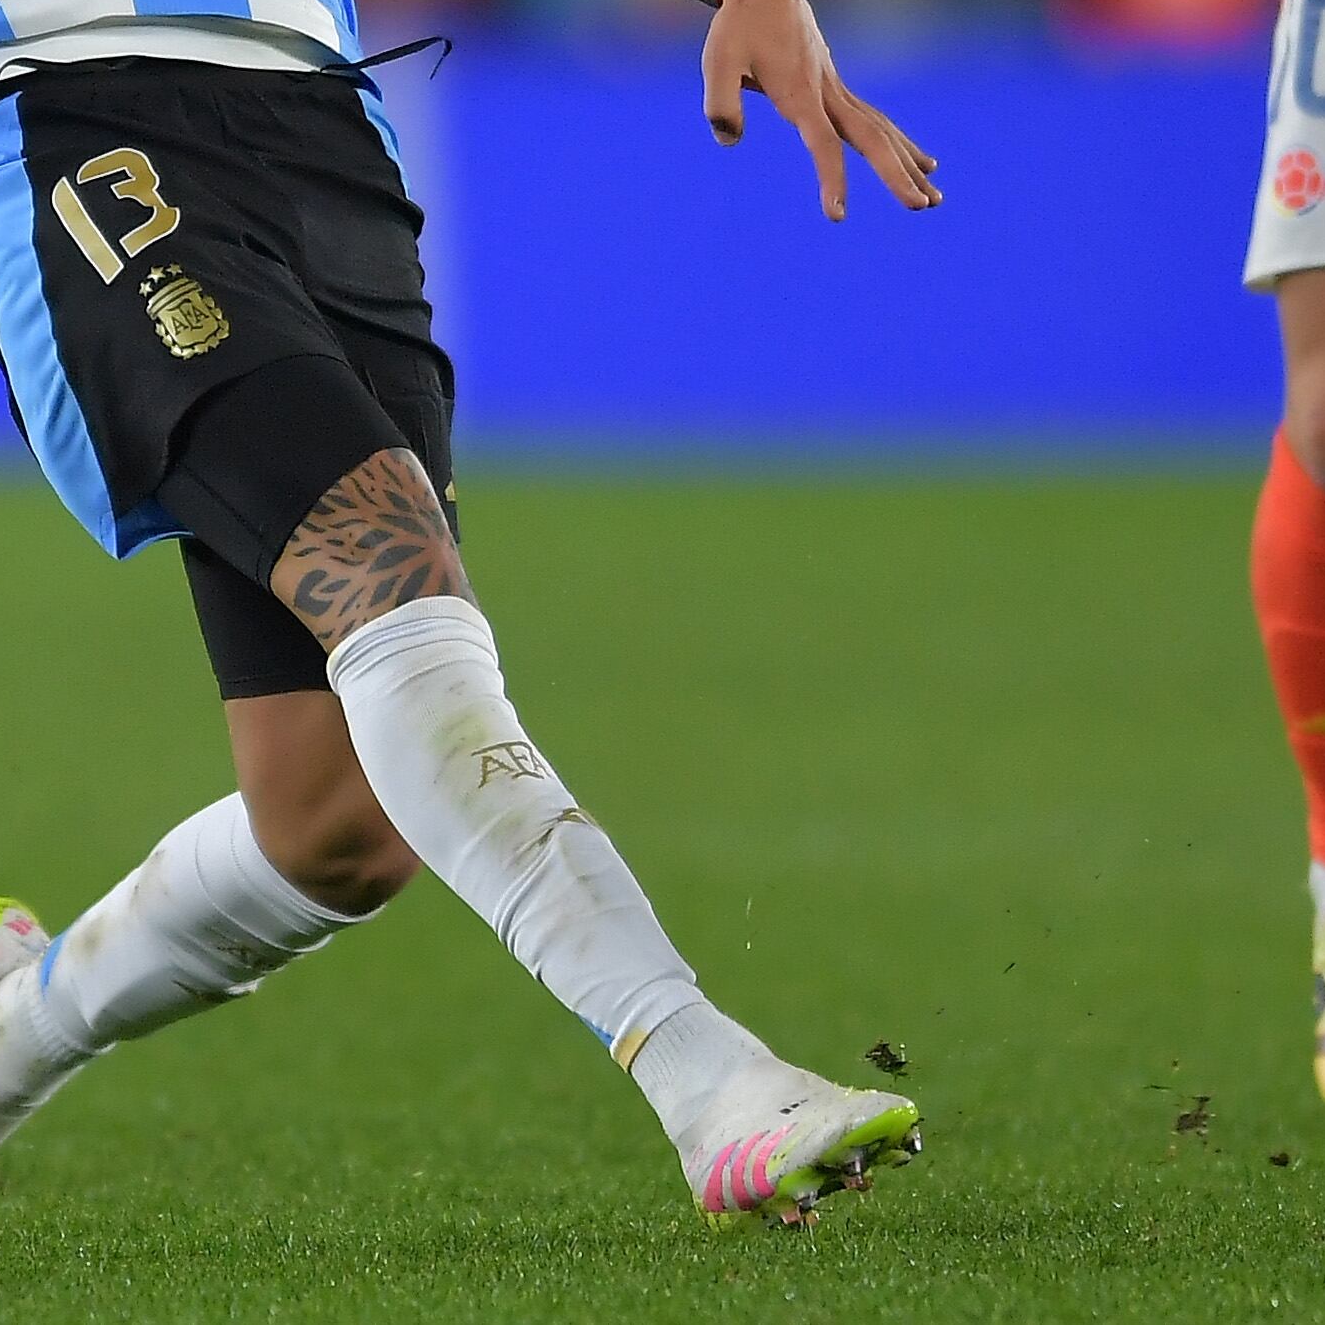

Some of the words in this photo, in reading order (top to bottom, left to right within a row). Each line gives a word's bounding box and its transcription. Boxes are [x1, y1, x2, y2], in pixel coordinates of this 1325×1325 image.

[52, 147, 180, 284] 13
[166, 298, 210, 335] AFA
[471, 741, 551, 788] AFA
